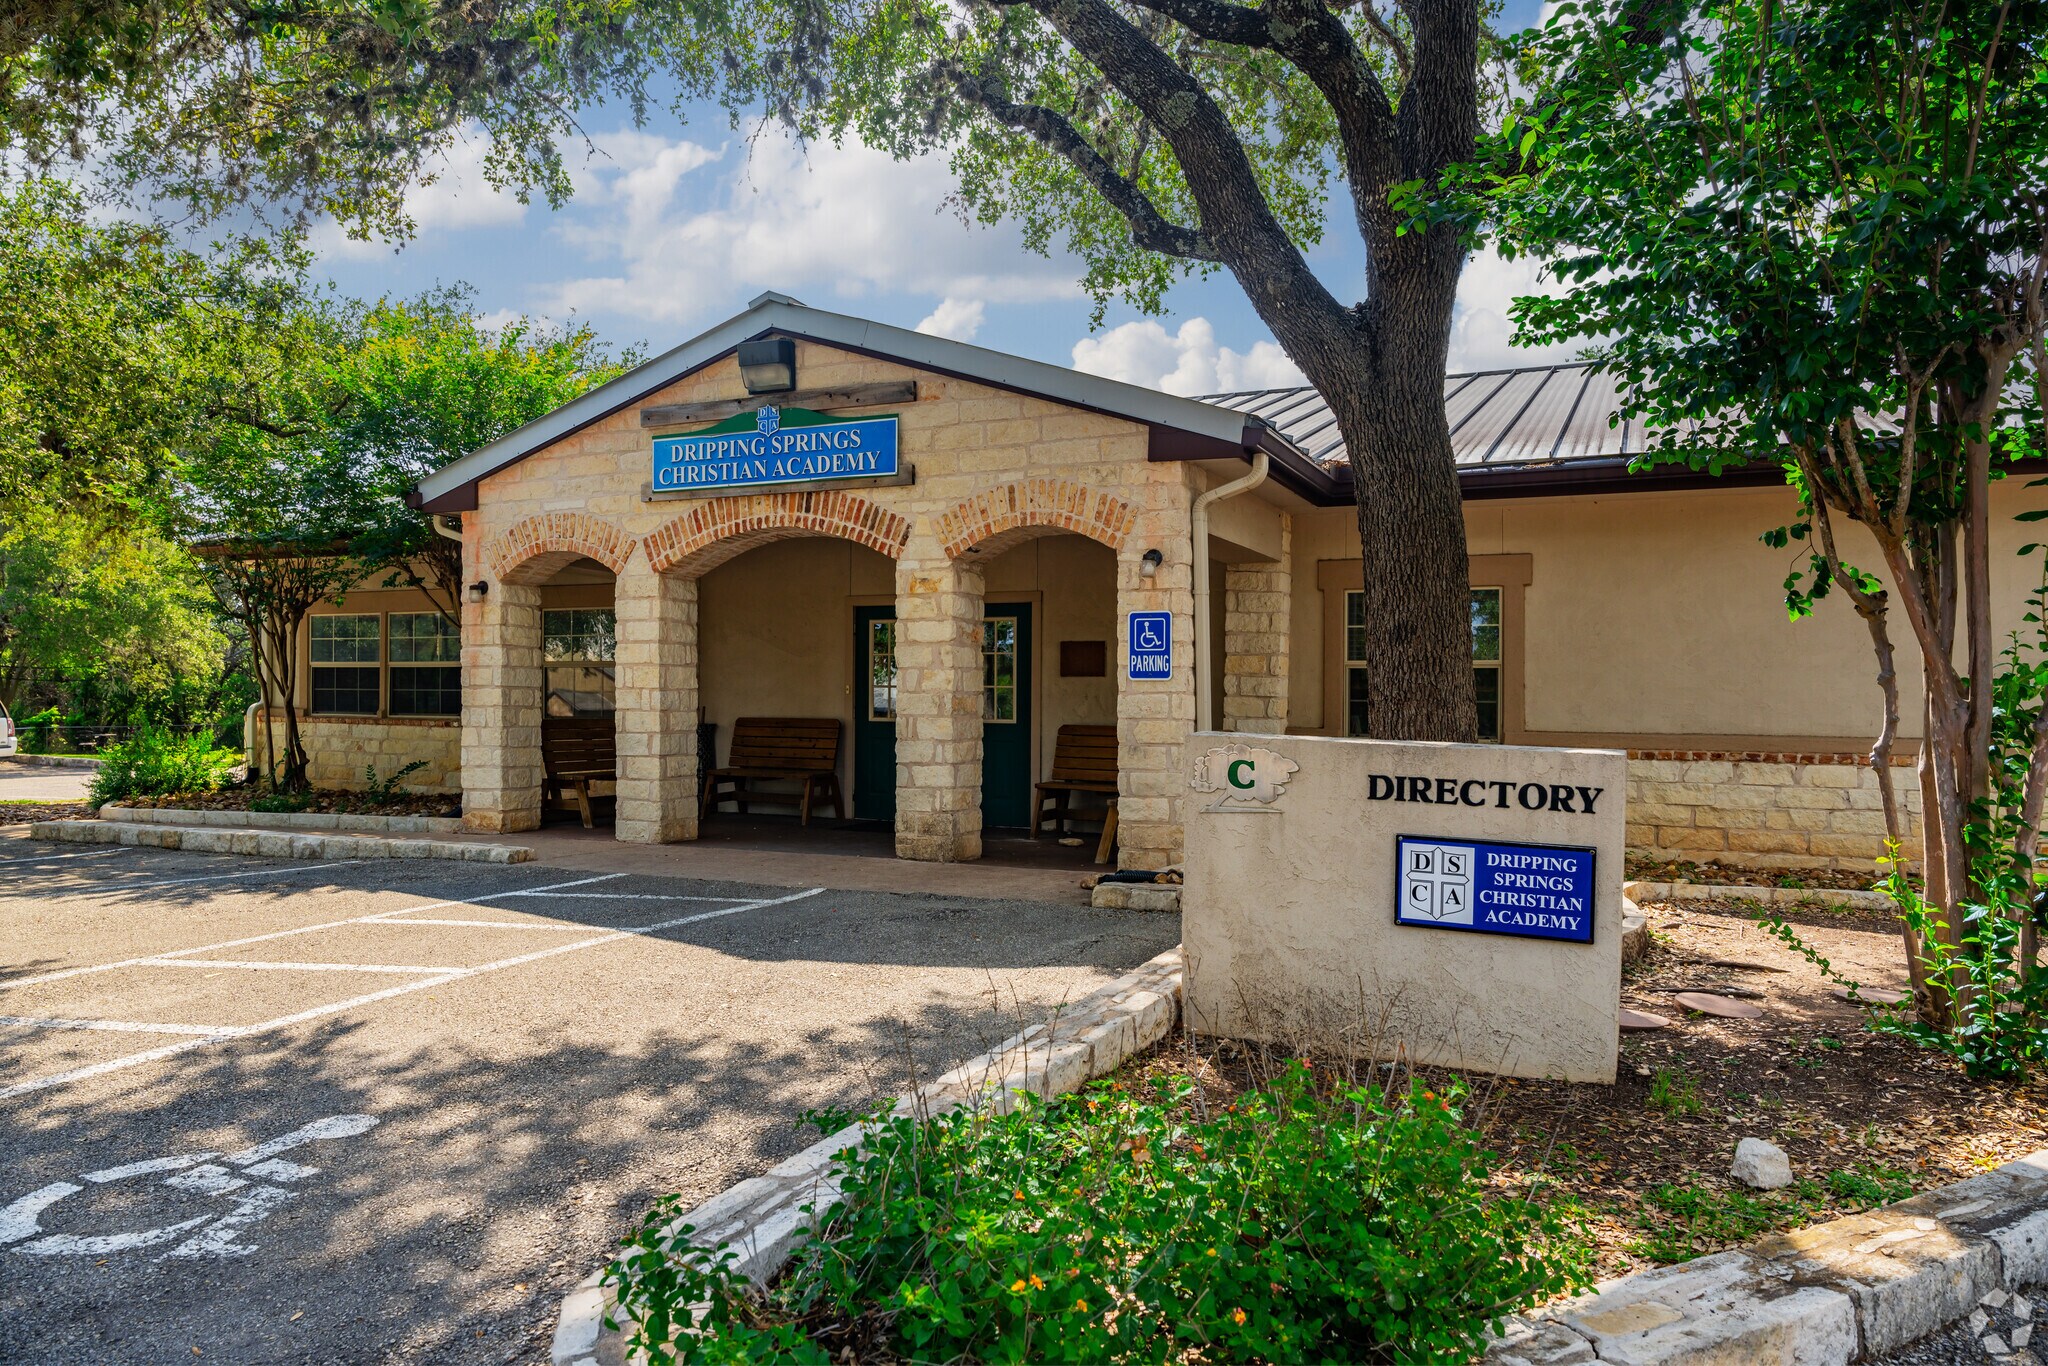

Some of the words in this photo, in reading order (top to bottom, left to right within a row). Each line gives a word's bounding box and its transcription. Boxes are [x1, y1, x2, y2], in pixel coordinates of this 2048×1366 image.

[670, 437, 766, 463] DRIPPING
[771, 429, 861, 456] SPRINGS
[658, 460, 767, 485] CHRISTIAN
[772, 450, 881, 477] ACADEMY
[1131, 655, 1169, 672] PARKING
[1227, 759, 1255, 790] C
[1367, 774, 1604, 815] DIRECTORY
[1414, 853, 1431, 870] D
[1447, 856, 1461, 873] S
[1486, 853, 1578, 873] DRIPPING
[1494, 872, 1574, 892] SPRINGS
[1412, 885, 1428, 902] C
[1445, 888, 1462, 906] A
[1479, 890, 1584, 912] CHRISTIAN
[1485, 909, 1582, 931] ACADEMY
